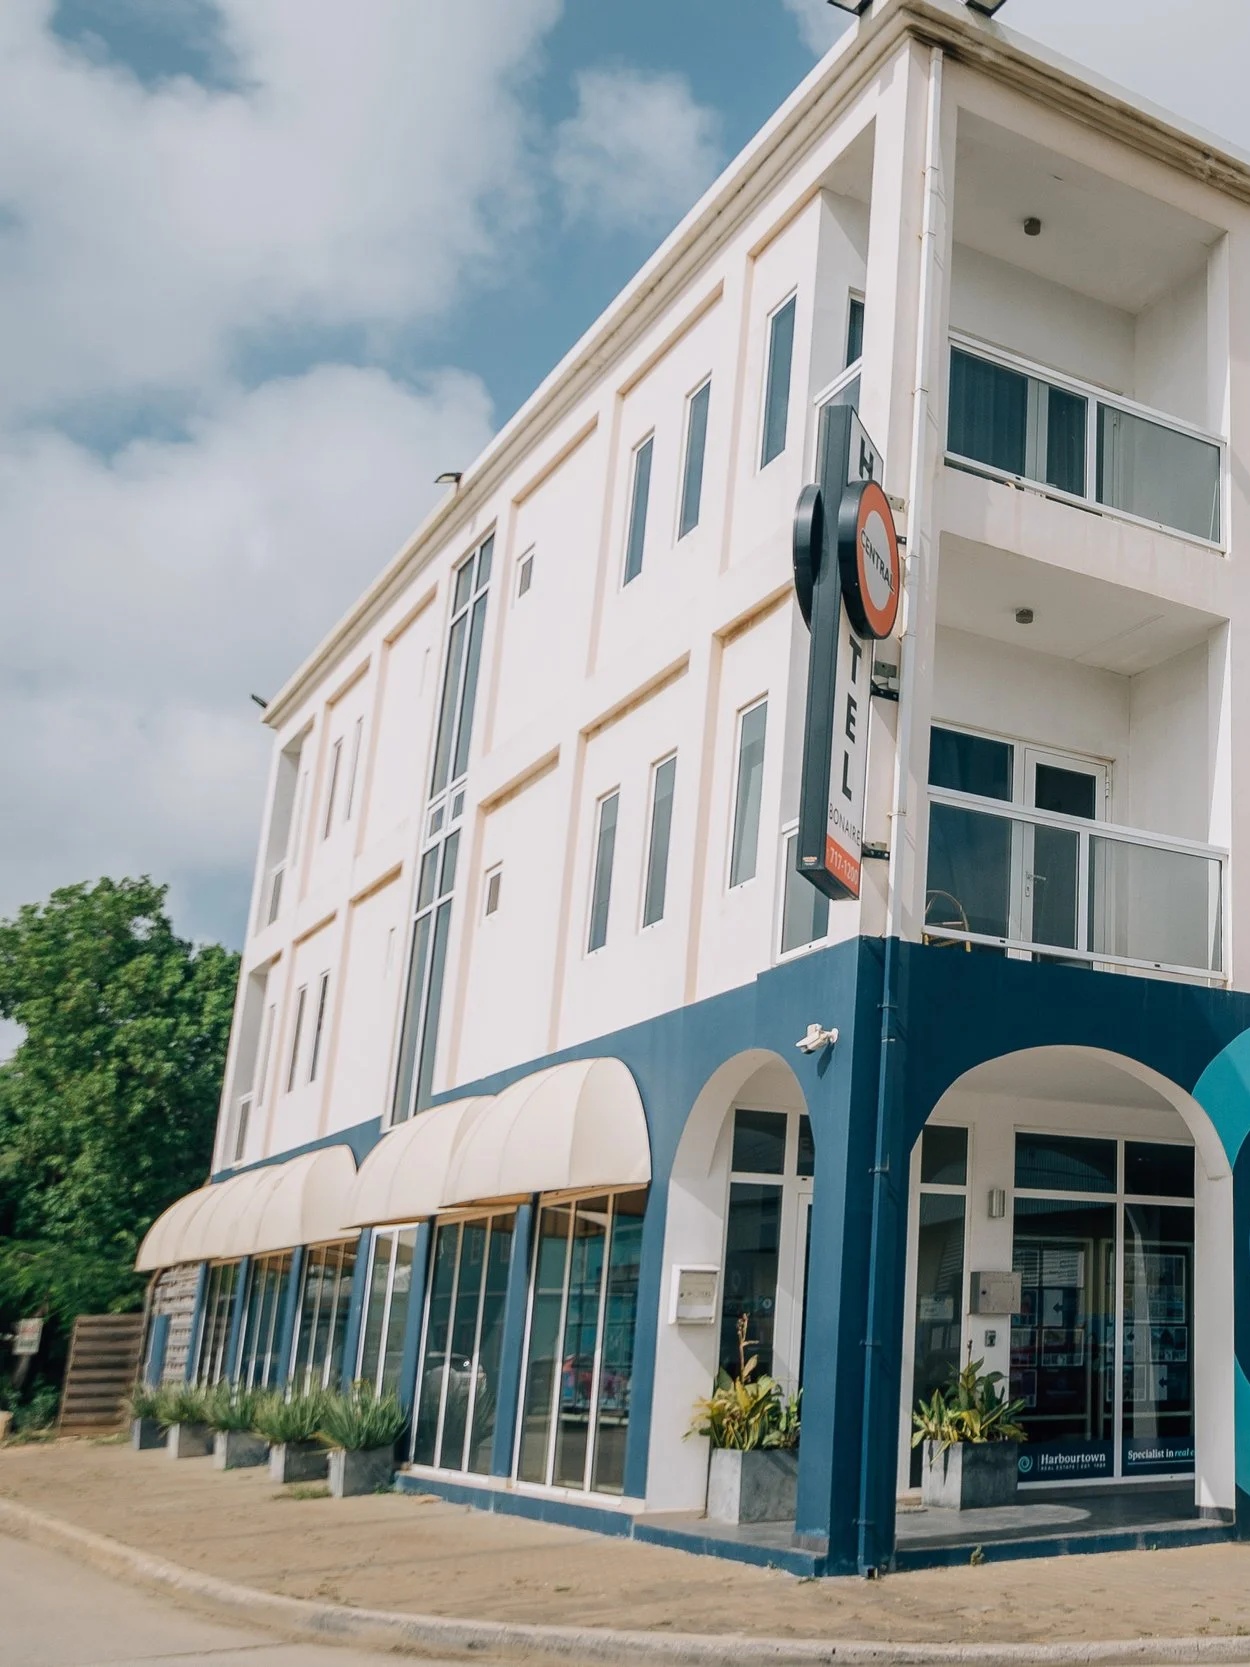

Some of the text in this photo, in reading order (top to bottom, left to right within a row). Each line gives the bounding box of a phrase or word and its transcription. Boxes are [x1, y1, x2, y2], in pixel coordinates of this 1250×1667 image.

[860, 527, 896, 596] CENTRAL
[829, 802, 861, 846] BONAIRE
[1041, 1453, 1106, 1465] Harbourtown
[1128, 1449, 1165, 1461] Specialist
[1166, 1448, 1174, 1458] in
[1175, 1448, 1189, 1458] real
